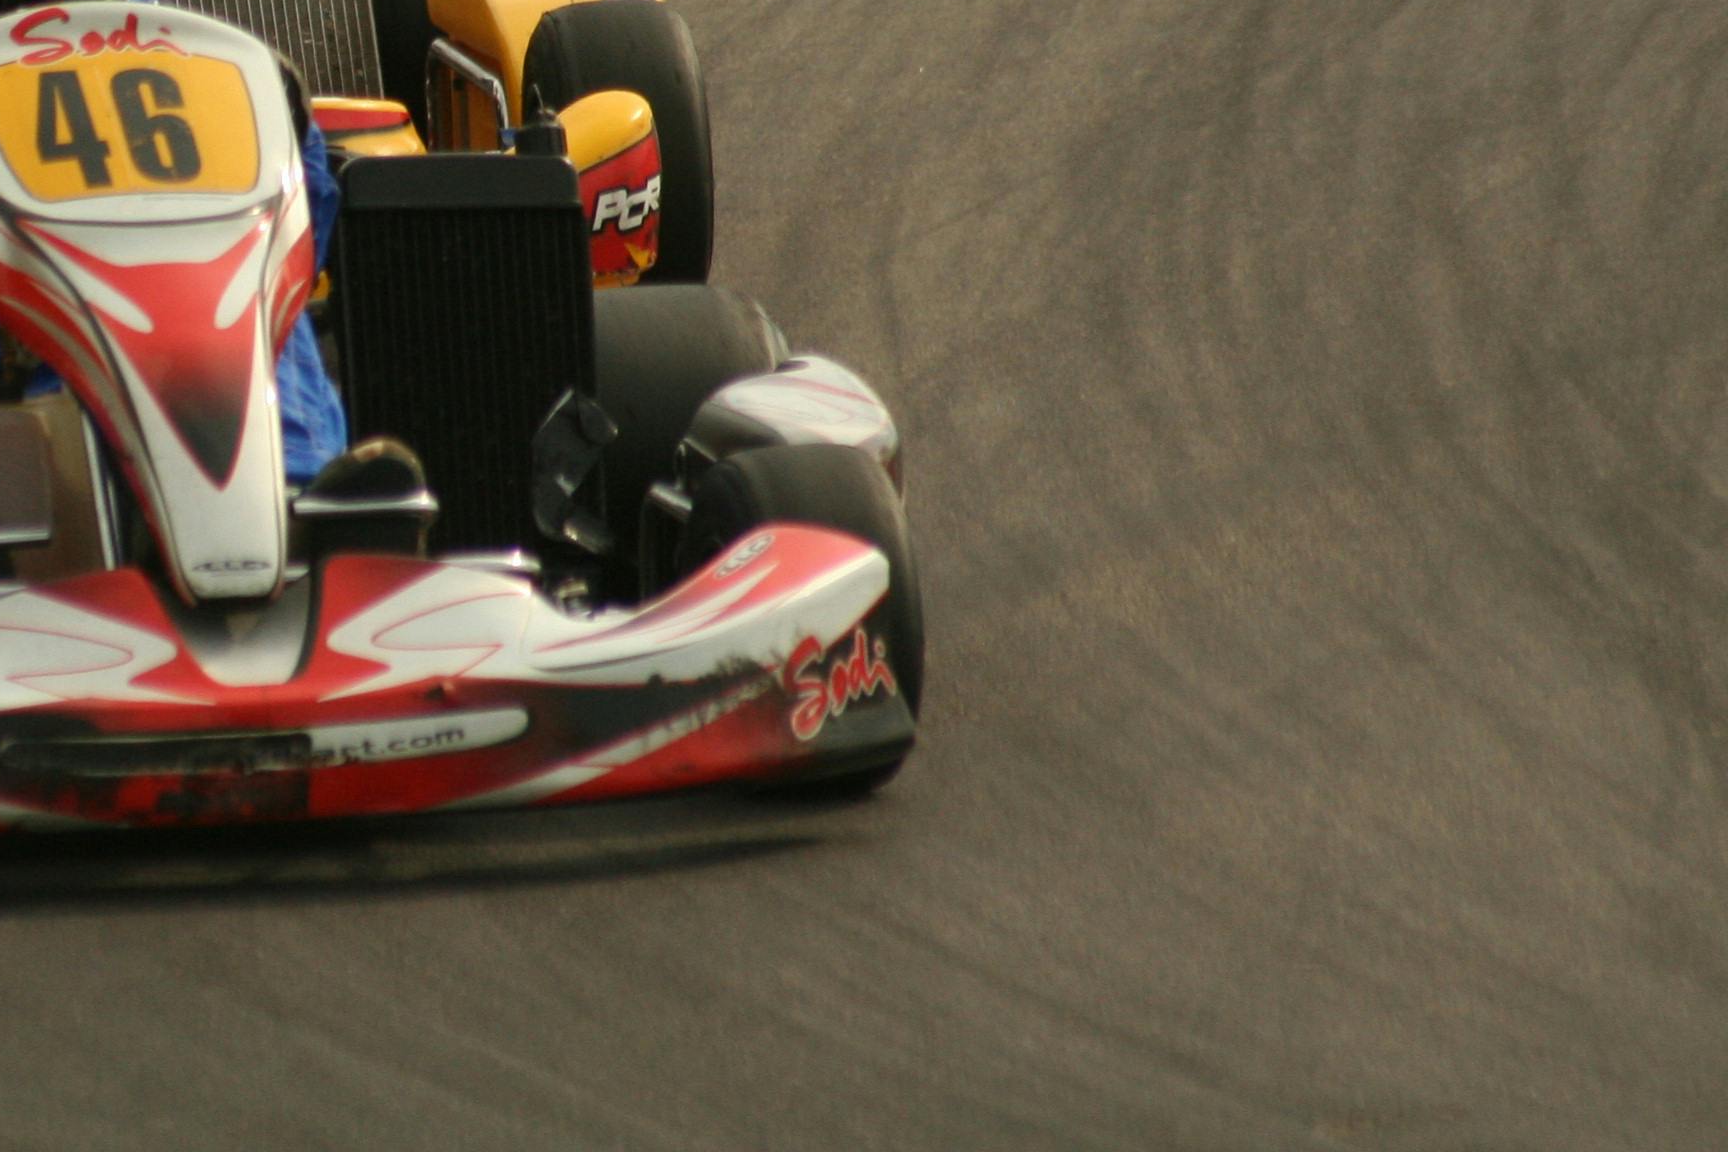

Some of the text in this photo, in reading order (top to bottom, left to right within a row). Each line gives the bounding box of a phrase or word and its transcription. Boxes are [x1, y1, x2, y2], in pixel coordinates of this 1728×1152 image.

[10, 7, 192, 65] Sodi
[35, 68, 202, 188] 46
[592, 174, 661, 232] PCR
[782, 631, 897, 741] Sodi
